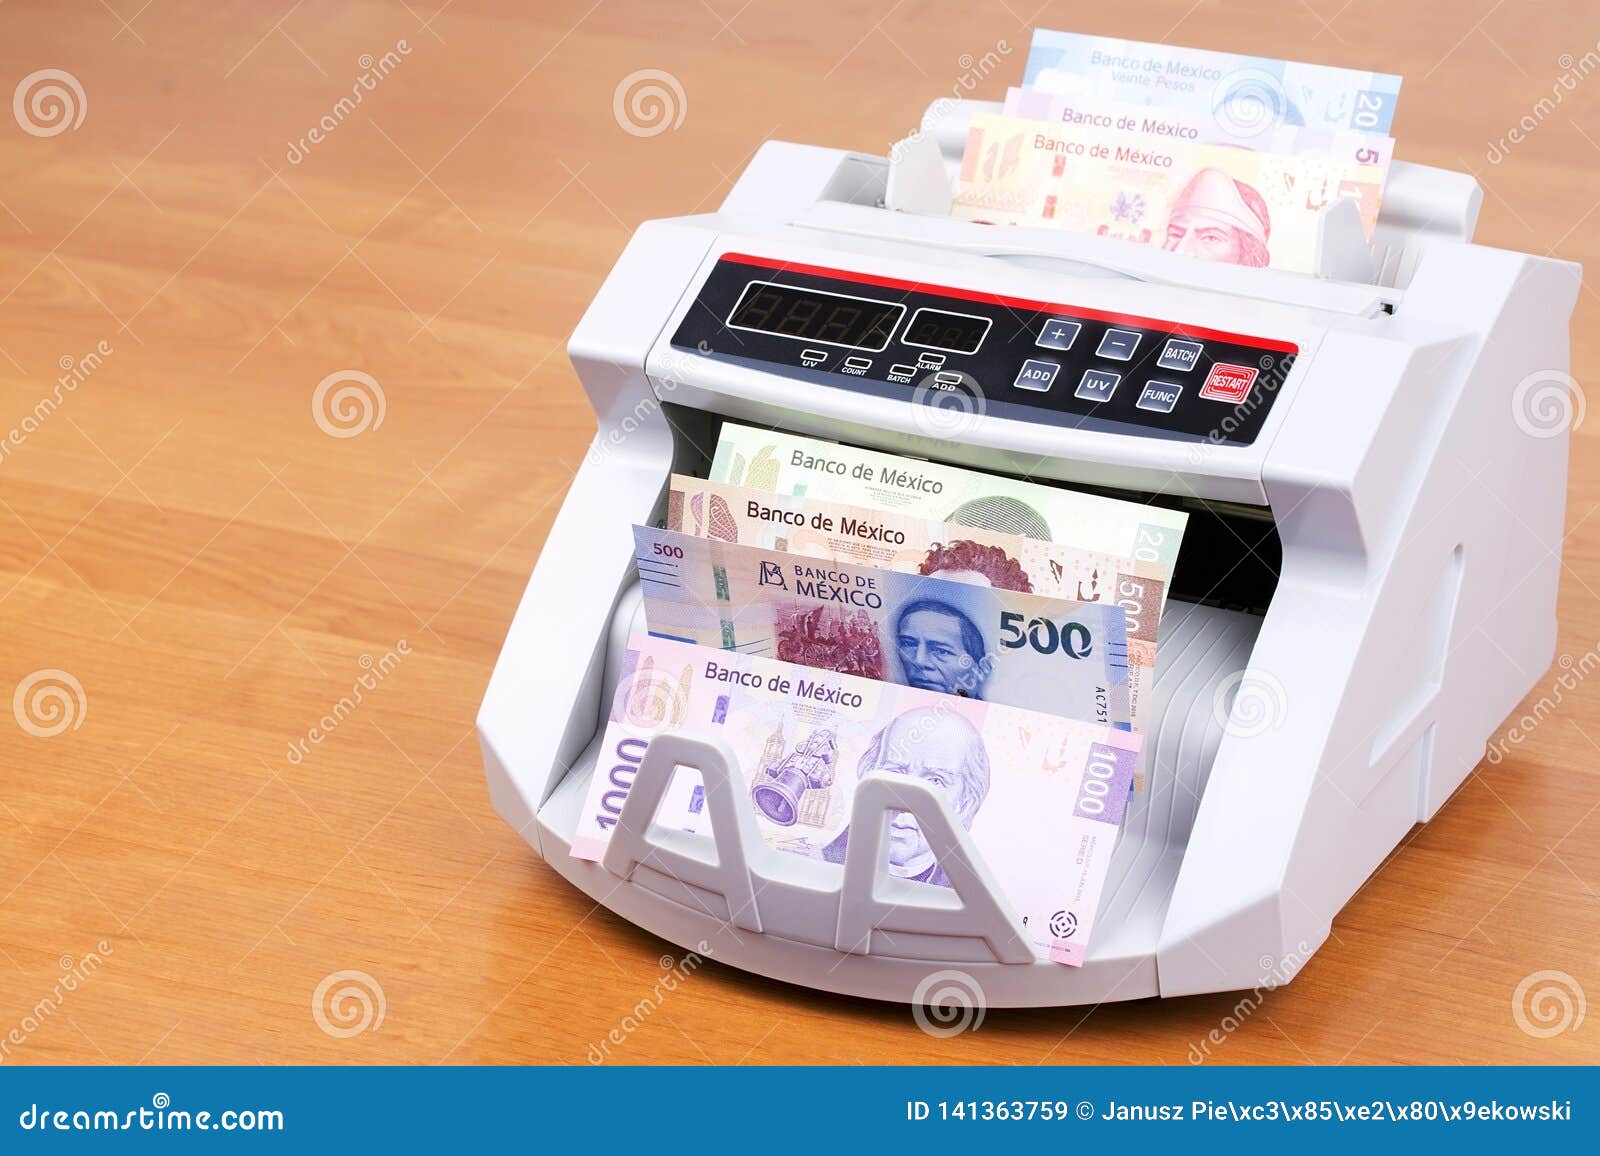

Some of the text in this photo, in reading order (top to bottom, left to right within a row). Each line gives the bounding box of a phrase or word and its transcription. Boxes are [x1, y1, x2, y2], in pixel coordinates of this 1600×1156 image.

[1062, 107, 1198, 140] Banco de México
[1034, 134, 1173, 168] Banco de México
[1165, 346, 1196, 363] BATCH
[802, 360, 818, 368] UV
[841, 366, 867, 377] COUNT
[915, 361, 942, 372] ALARM
[887, 374, 911, 385] BATCH
[1022, 369, 1051, 383] ADD
[1086, 378, 1111, 391] UV
[1209, 374, 1248, 391] RESTART
[931, 382, 956, 393] ADD
[1143, 389, 1176, 404] FUNC
[790, 449, 943, 495] Banco de México
[747, 501, 905, 545] Banco de México
[653, 542, 684, 559] 500
[794, 565, 876, 590] BANCO DE
[796, 579, 883, 610] MÉXICO
[1000, 610, 1093, 660] 500
[704, 661, 863, 708] Banco de México
[1095, 686, 1108, 723] AC751
[1080, 750, 1118, 814] 1000
